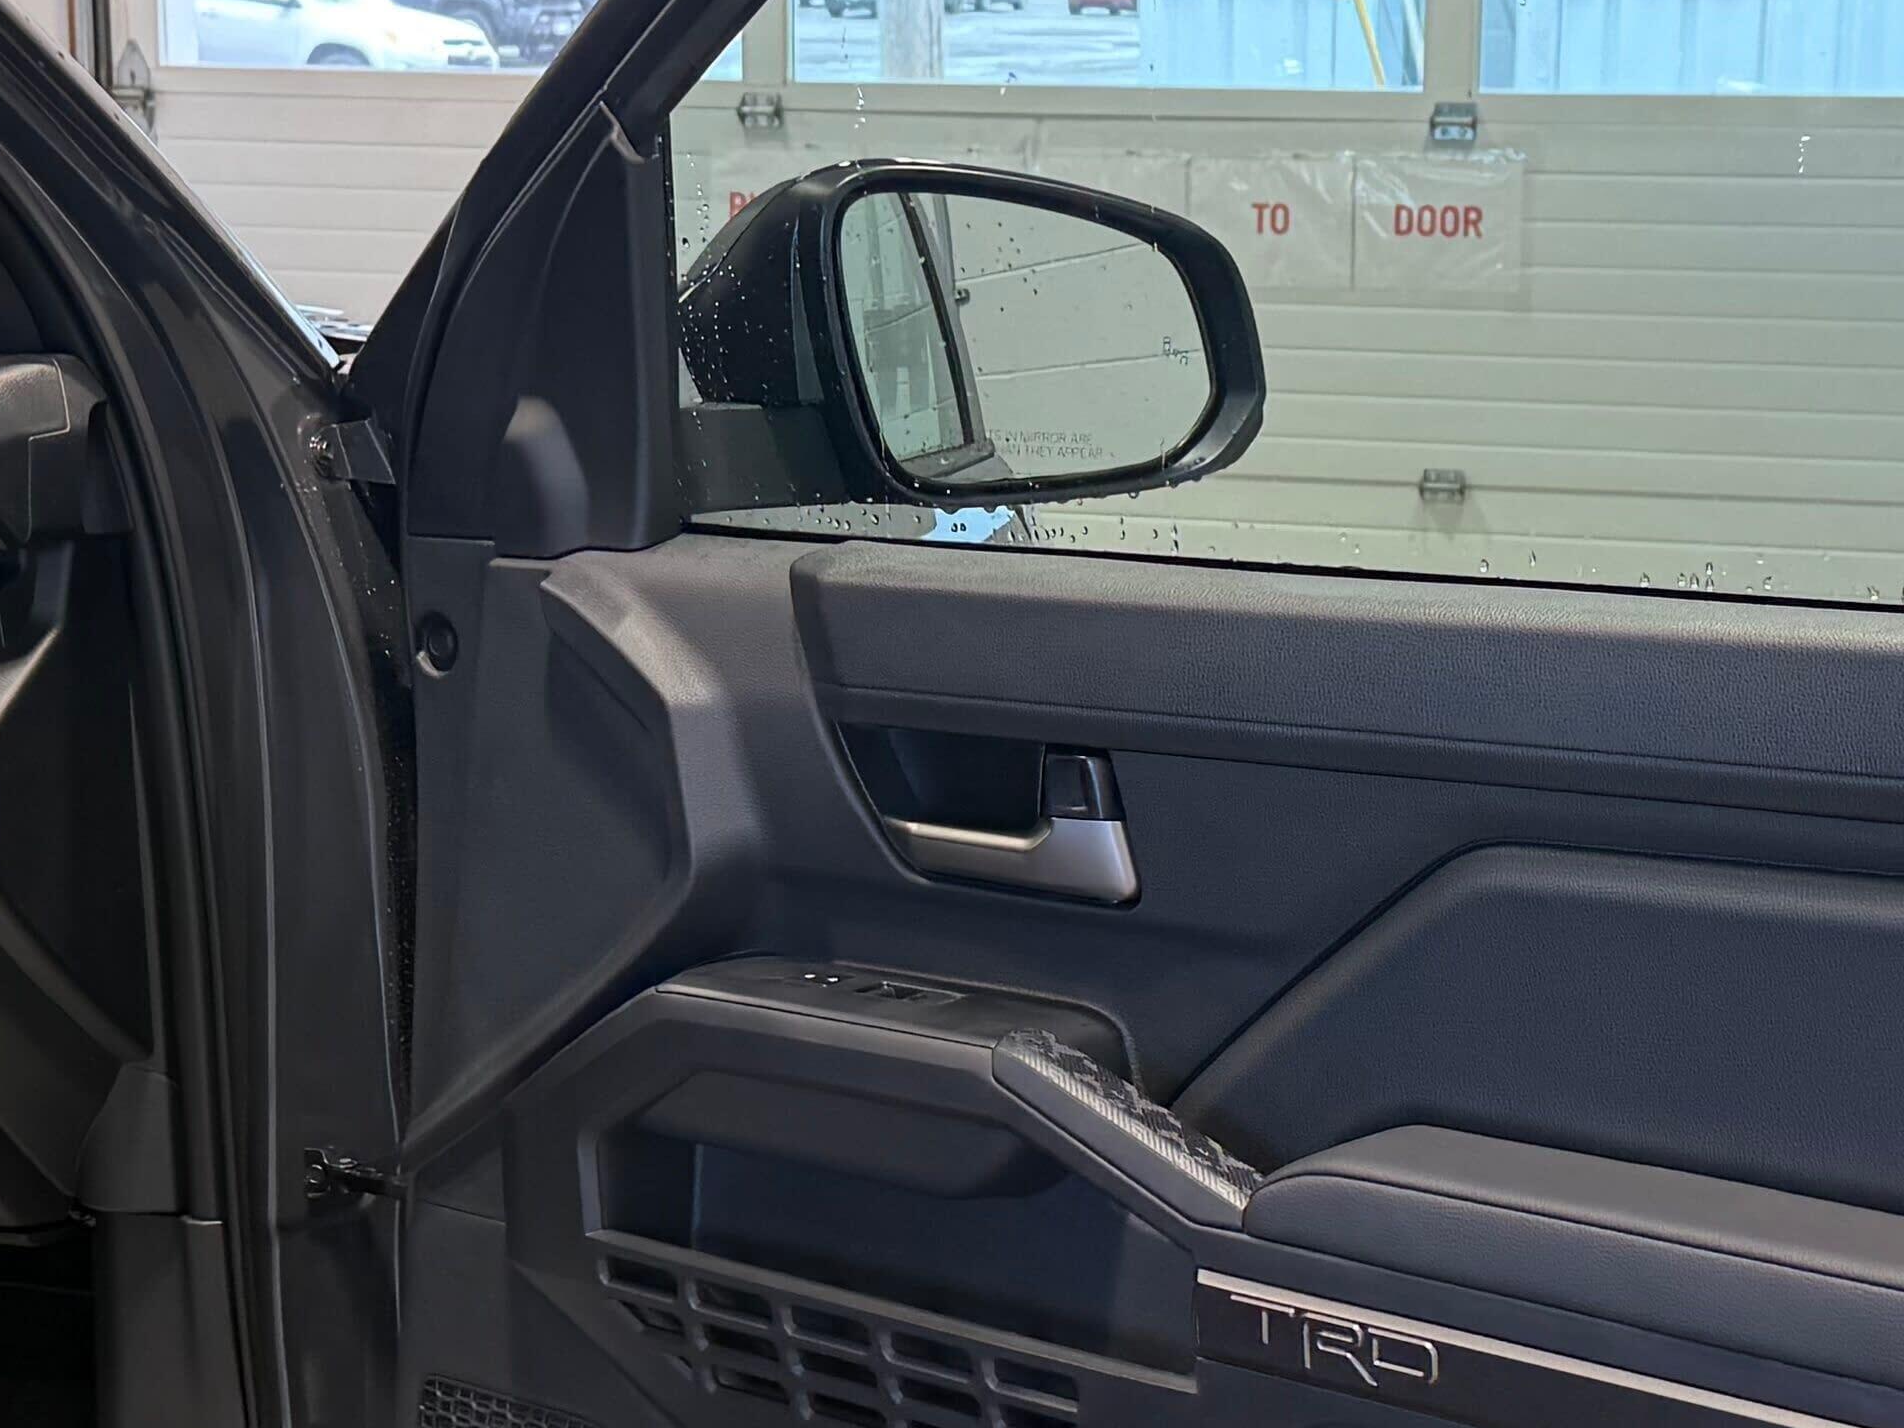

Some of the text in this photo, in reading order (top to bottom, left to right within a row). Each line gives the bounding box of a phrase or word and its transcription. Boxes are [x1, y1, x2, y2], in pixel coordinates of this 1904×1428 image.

[1251, 202, 1484, 240] TO DOOR
[1230, 1294, 1440, 1388] TRD
